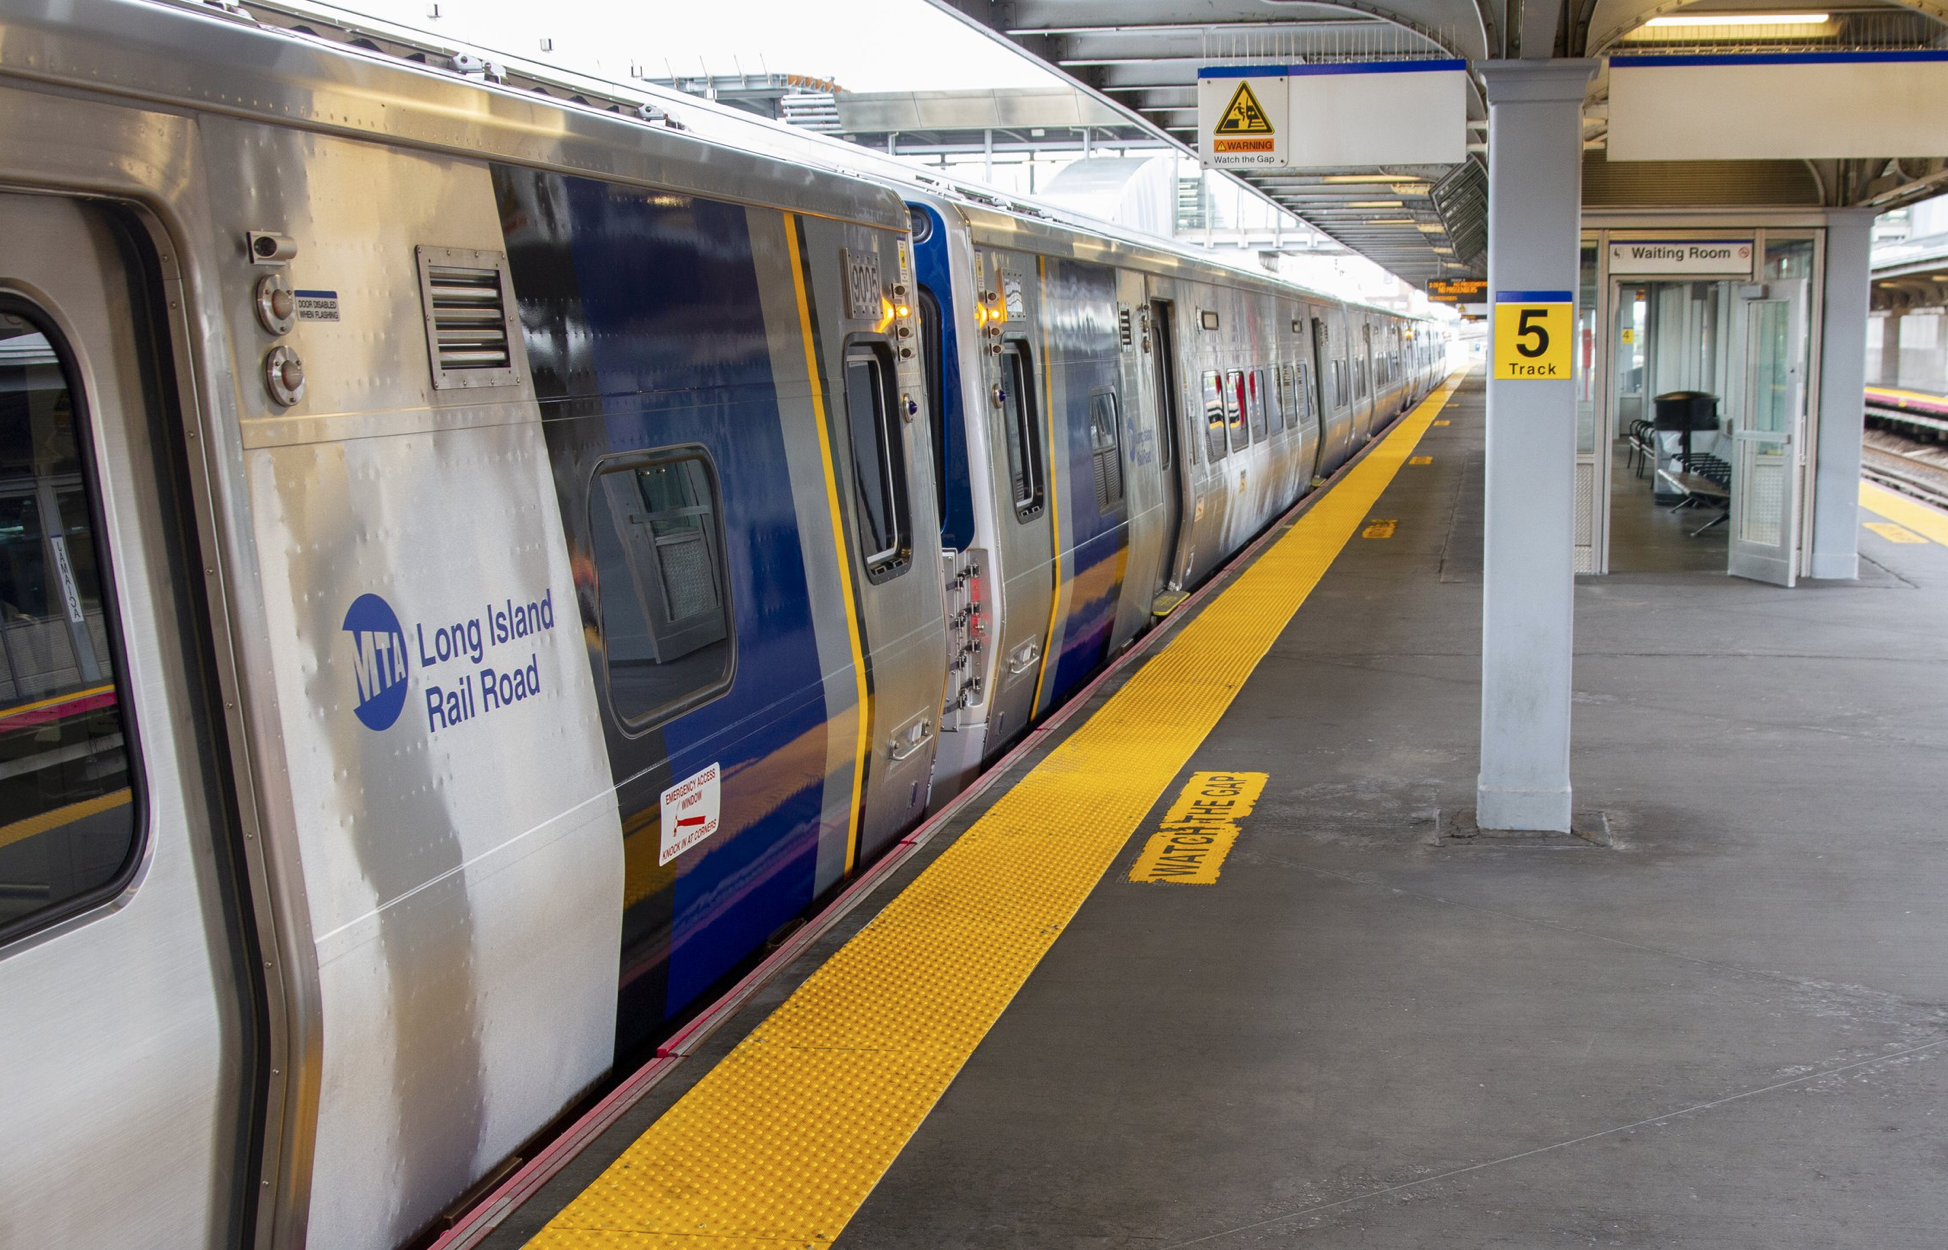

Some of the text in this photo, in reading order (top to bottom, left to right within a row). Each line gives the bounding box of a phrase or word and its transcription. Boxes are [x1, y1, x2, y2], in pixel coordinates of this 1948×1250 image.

[1227, 141, 1273, 150] WARNING
[1257, 155, 1275, 164] Gap
[1631, 246, 1731, 261] Waiting Room
[298, 299, 337, 309] DOOR DISABLED
[300, 310, 339, 319] WHEN FLASHING
[1516, 309, 1550, 358] 5
[1623, 330, 1630, 340] 4
[1508, 362, 1556, 375] Track
[416, 588, 555, 668] Long Island
[352, 630, 407, 703] MTA
[425, 653, 541, 733] Rail Road
[665, 768, 716, 805] EMERGENCY ACCESS
[681, 789, 703, 811] WINDOW
[1148, 775, 1248, 877] WATCH THE GAP
[662, 818, 717, 859] KNOCK IN AT CORNERS
